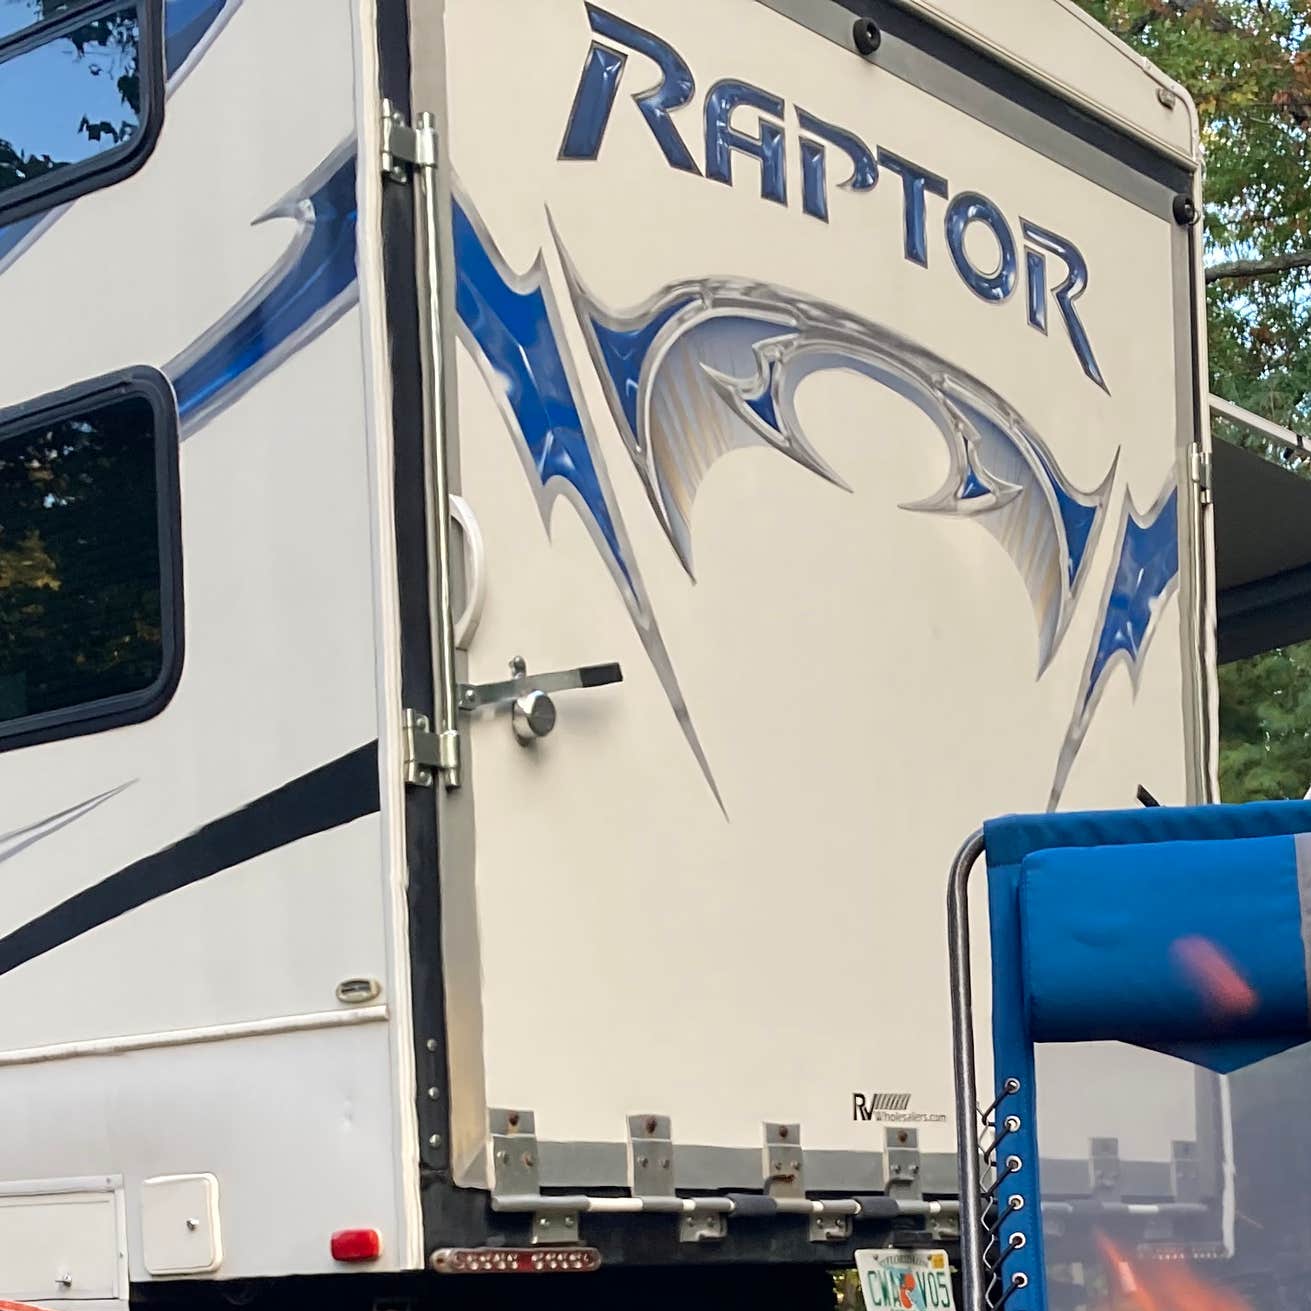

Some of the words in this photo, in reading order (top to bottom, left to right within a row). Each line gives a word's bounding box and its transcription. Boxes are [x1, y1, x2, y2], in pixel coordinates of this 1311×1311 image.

[557, 0, 1111, 397] RAPTOR
[853, 1093, 878, 1121] RV
[915, 1271, 951, 1308] V05
